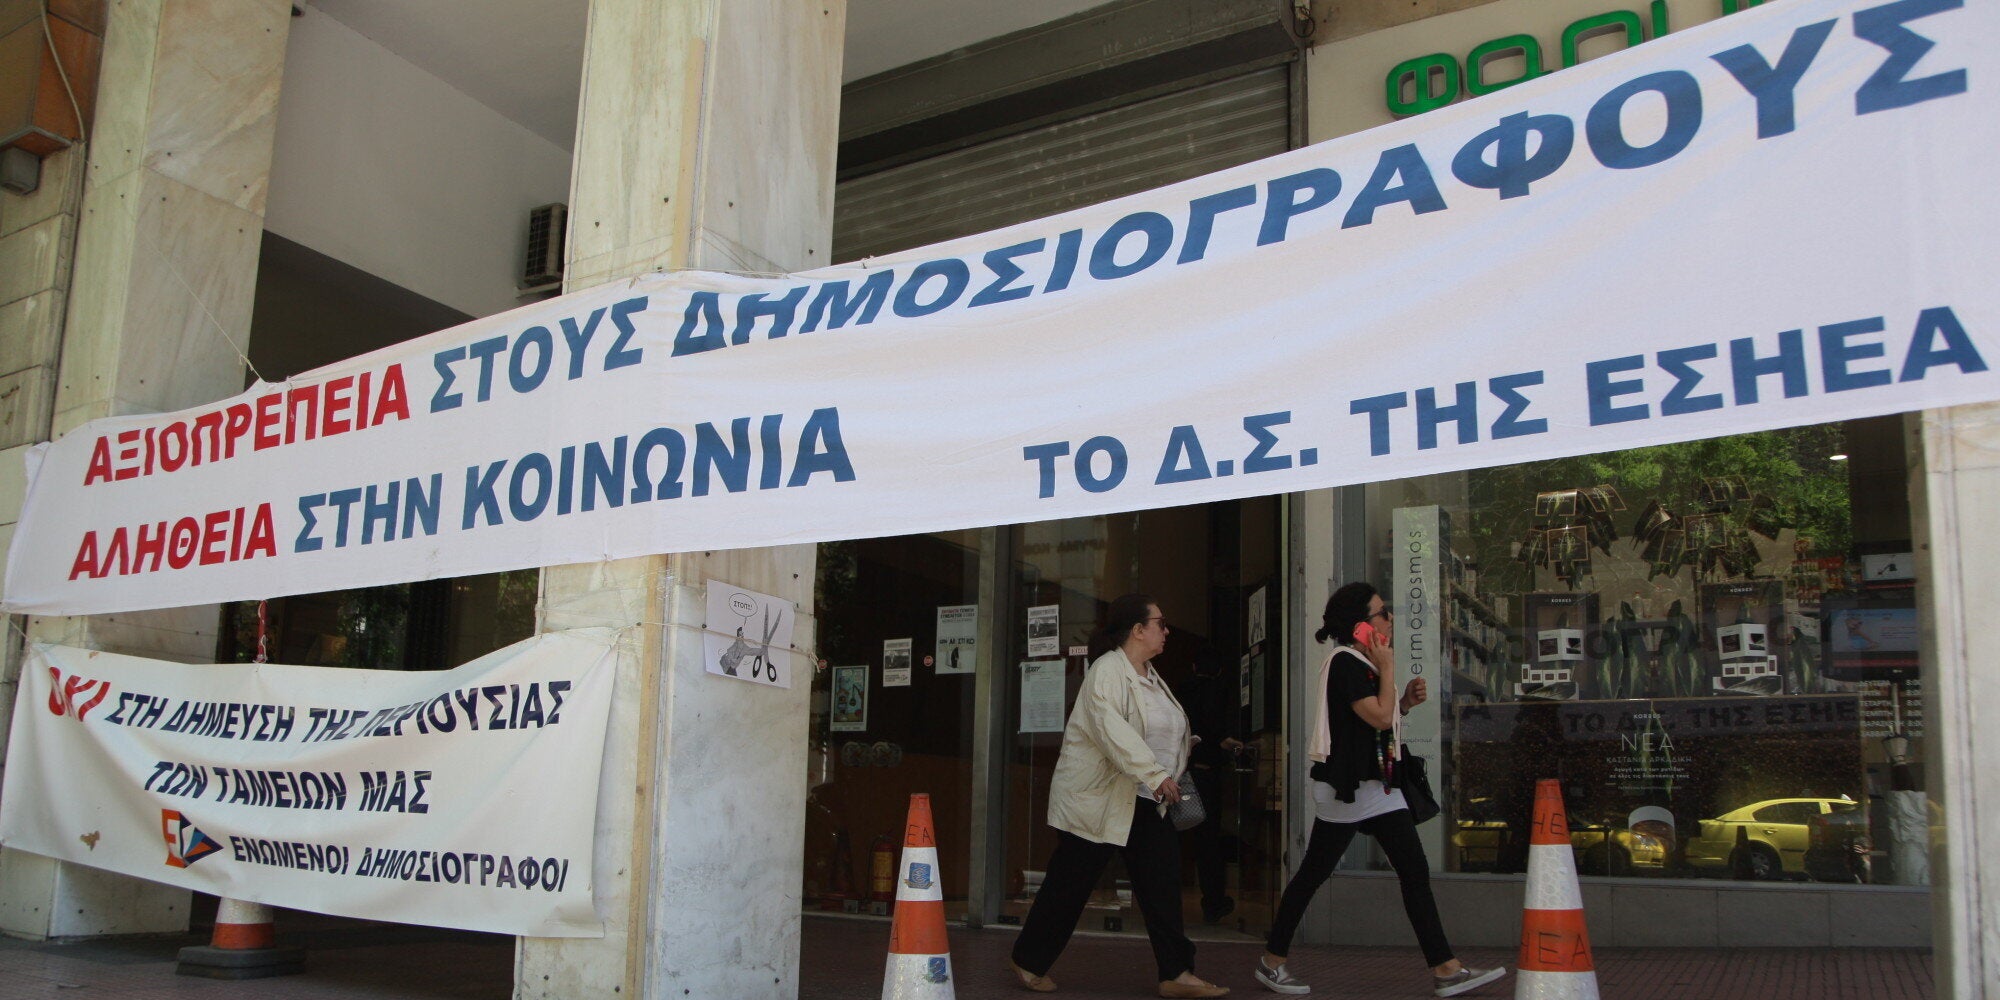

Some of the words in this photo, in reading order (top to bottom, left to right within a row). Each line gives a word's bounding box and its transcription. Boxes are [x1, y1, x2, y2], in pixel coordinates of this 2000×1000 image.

[84, 363, 410, 486] ΑΞΙΟΠΡΕΠΕΙΑ
[432, 298, 647, 411] ΣΤΟΥΣ
[672, 0, 1968, 356] ΔΗΜΟΣΙΟΓΡΑΦΟΥΣ
[1025, 436, 1127, 498] ΤΟ
[1156, 411, 1318, 485] Δ.Σ.
[1350, 371, 1548, 456] ΤΗΣ
[1587, 306, 1988, 426] ΕΣΗΕΑ
[69, 503, 277, 580] ΑΛΗΘΕΙΑ
[295, 473, 442, 553] ΣΤΗΝ
[463, 408, 856, 530] ΚΟΙΝΩΝΙΑ
[1410, 530, 1423, 675] ermocosmos
[105, 691, 169, 728] ΣΤΗ
[161, 701, 295, 742] ΔΗΜΕΥΣΗ
[301, 707, 370, 742] ΤΗΣ
[353, 681, 571, 738] ΠΕΡΙΟΥΣΙΑΣ
[1621, 732, 1674, 751] ΝΕΑ
[144, 761, 209, 799] ΤΩΝ
[213, 767, 347, 811] ΤΑΜΕΙΩΝ
[358, 770, 433, 814] ΜΑΣ
[229, 836, 349, 875] ΕΝΩΜΕΝΟΙ
[355, 846, 569, 893] ΔΗΜΟΣΙΟΓΡΑΦΟΙ
